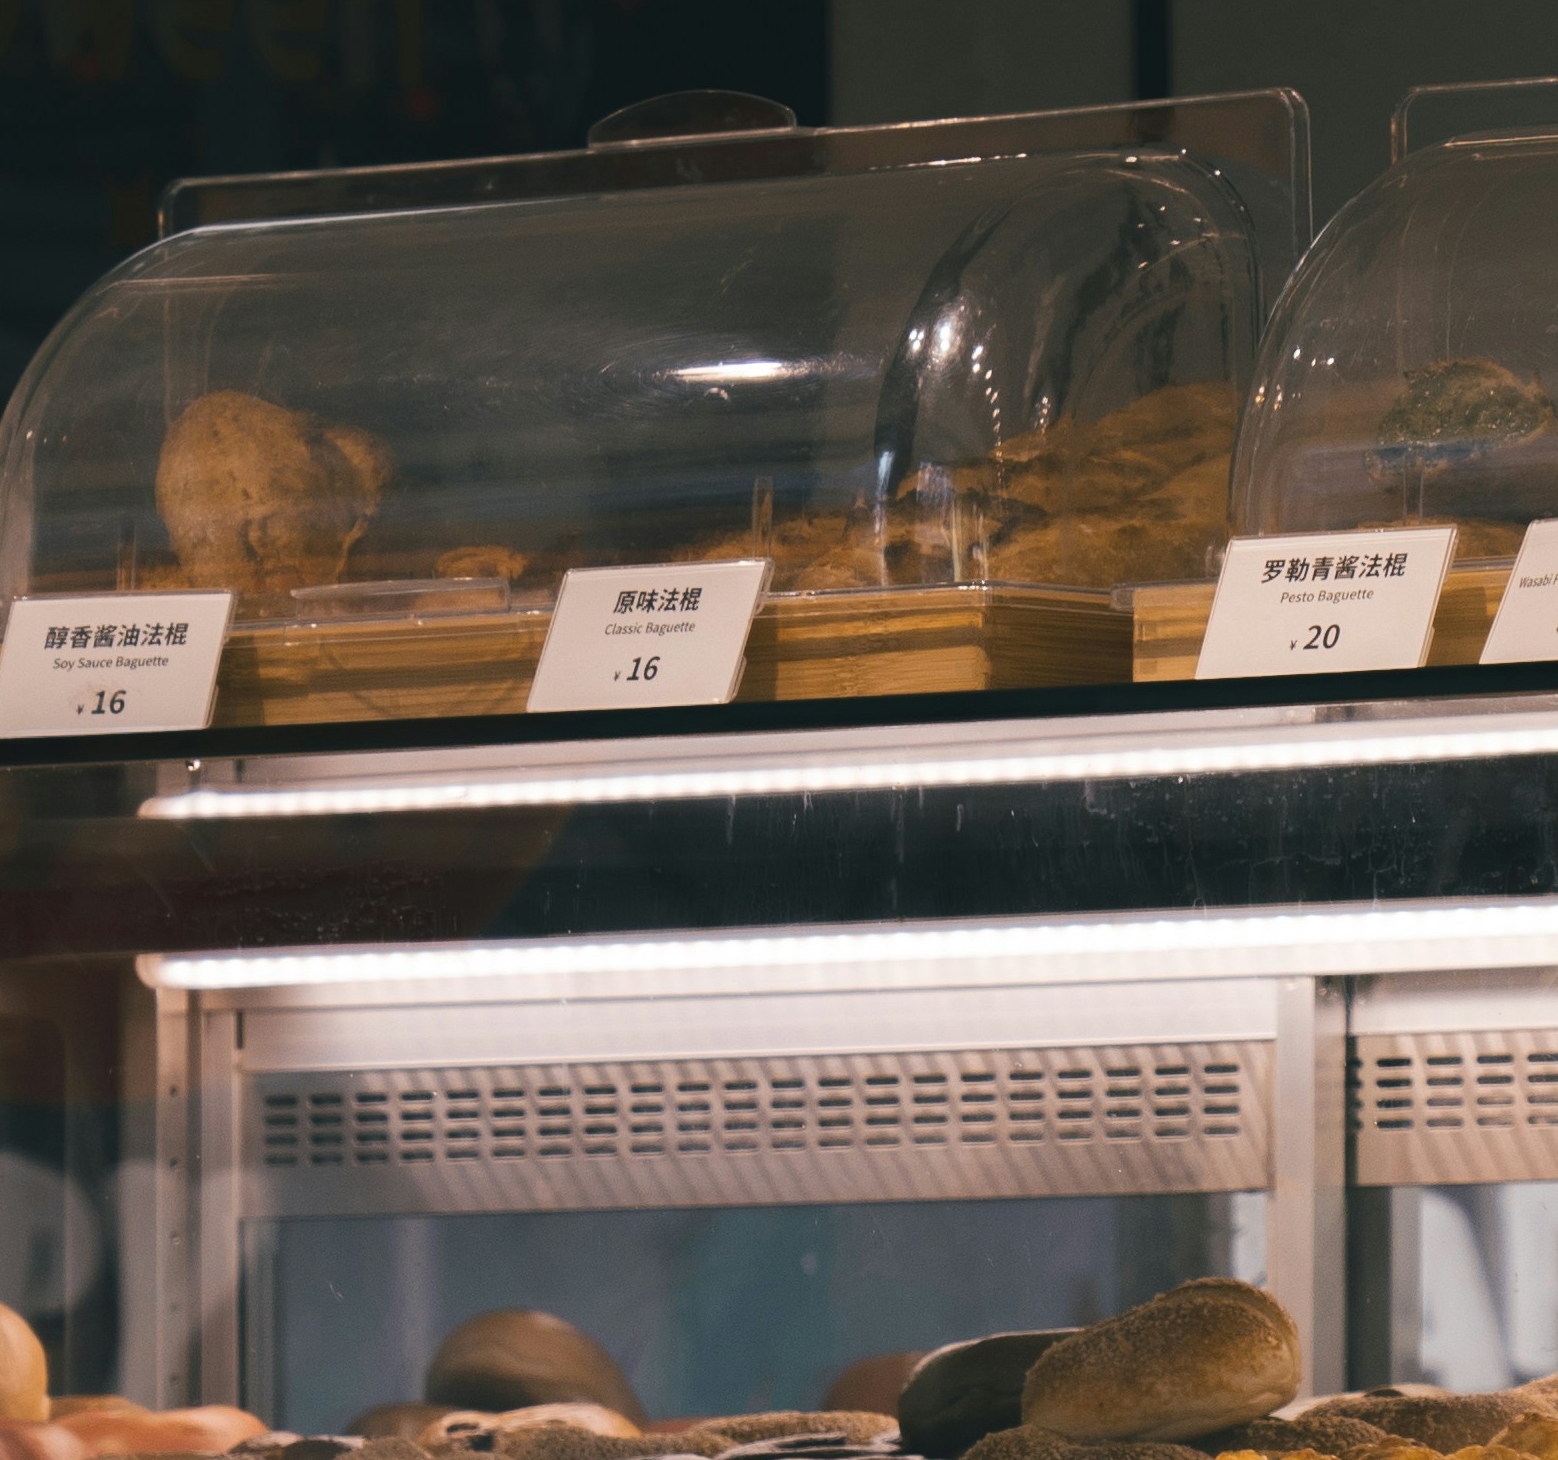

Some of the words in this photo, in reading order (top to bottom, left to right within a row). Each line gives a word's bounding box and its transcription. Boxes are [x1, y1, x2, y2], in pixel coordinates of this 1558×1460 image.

[1261, 553, 1407, 583] 罗勒青酱法棍
[1519, 574, 1552, 588] Wasabi
[613, 588, 702, 613] 原味法棍
[1280, 592, 1314, 603] Pesto
[1318, 589, 1374, 603] Baguette
[45, 623, 188, 650] 醇香酱油法棍
[605, 622, 642, 635] Classic
[646, 622, 695, 636] Baguette
[54, 658, 75, 671] Soy
[78, 658, 112, 669] Sauce
[116, 655, 168, 669] Baguette
